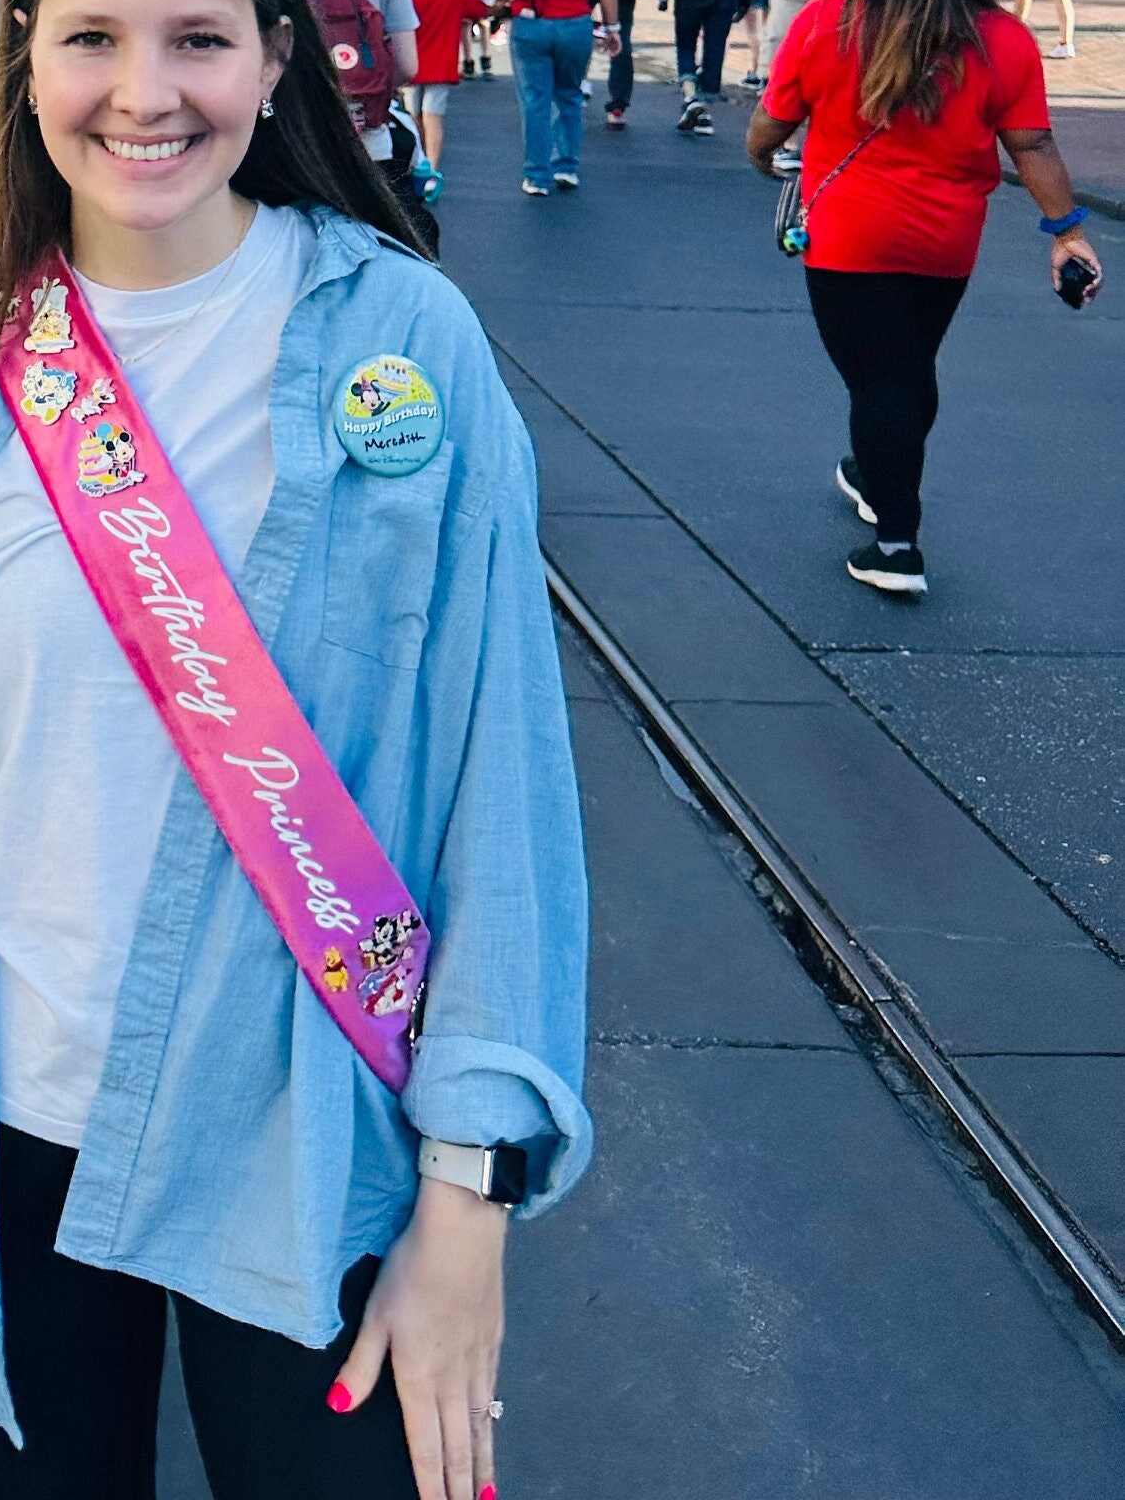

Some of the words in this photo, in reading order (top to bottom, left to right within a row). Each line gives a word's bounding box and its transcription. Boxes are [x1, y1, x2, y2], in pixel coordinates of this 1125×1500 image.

[344, 420, 382, 435] Happy
[384, 404, 438, 427] Birthday!
[364, 431, 426, 452] Meredith
[82, 484, 103, 495] Happy
[98, 496, 237, 727] Birthday
[223, 746, 361, 935] Princess
